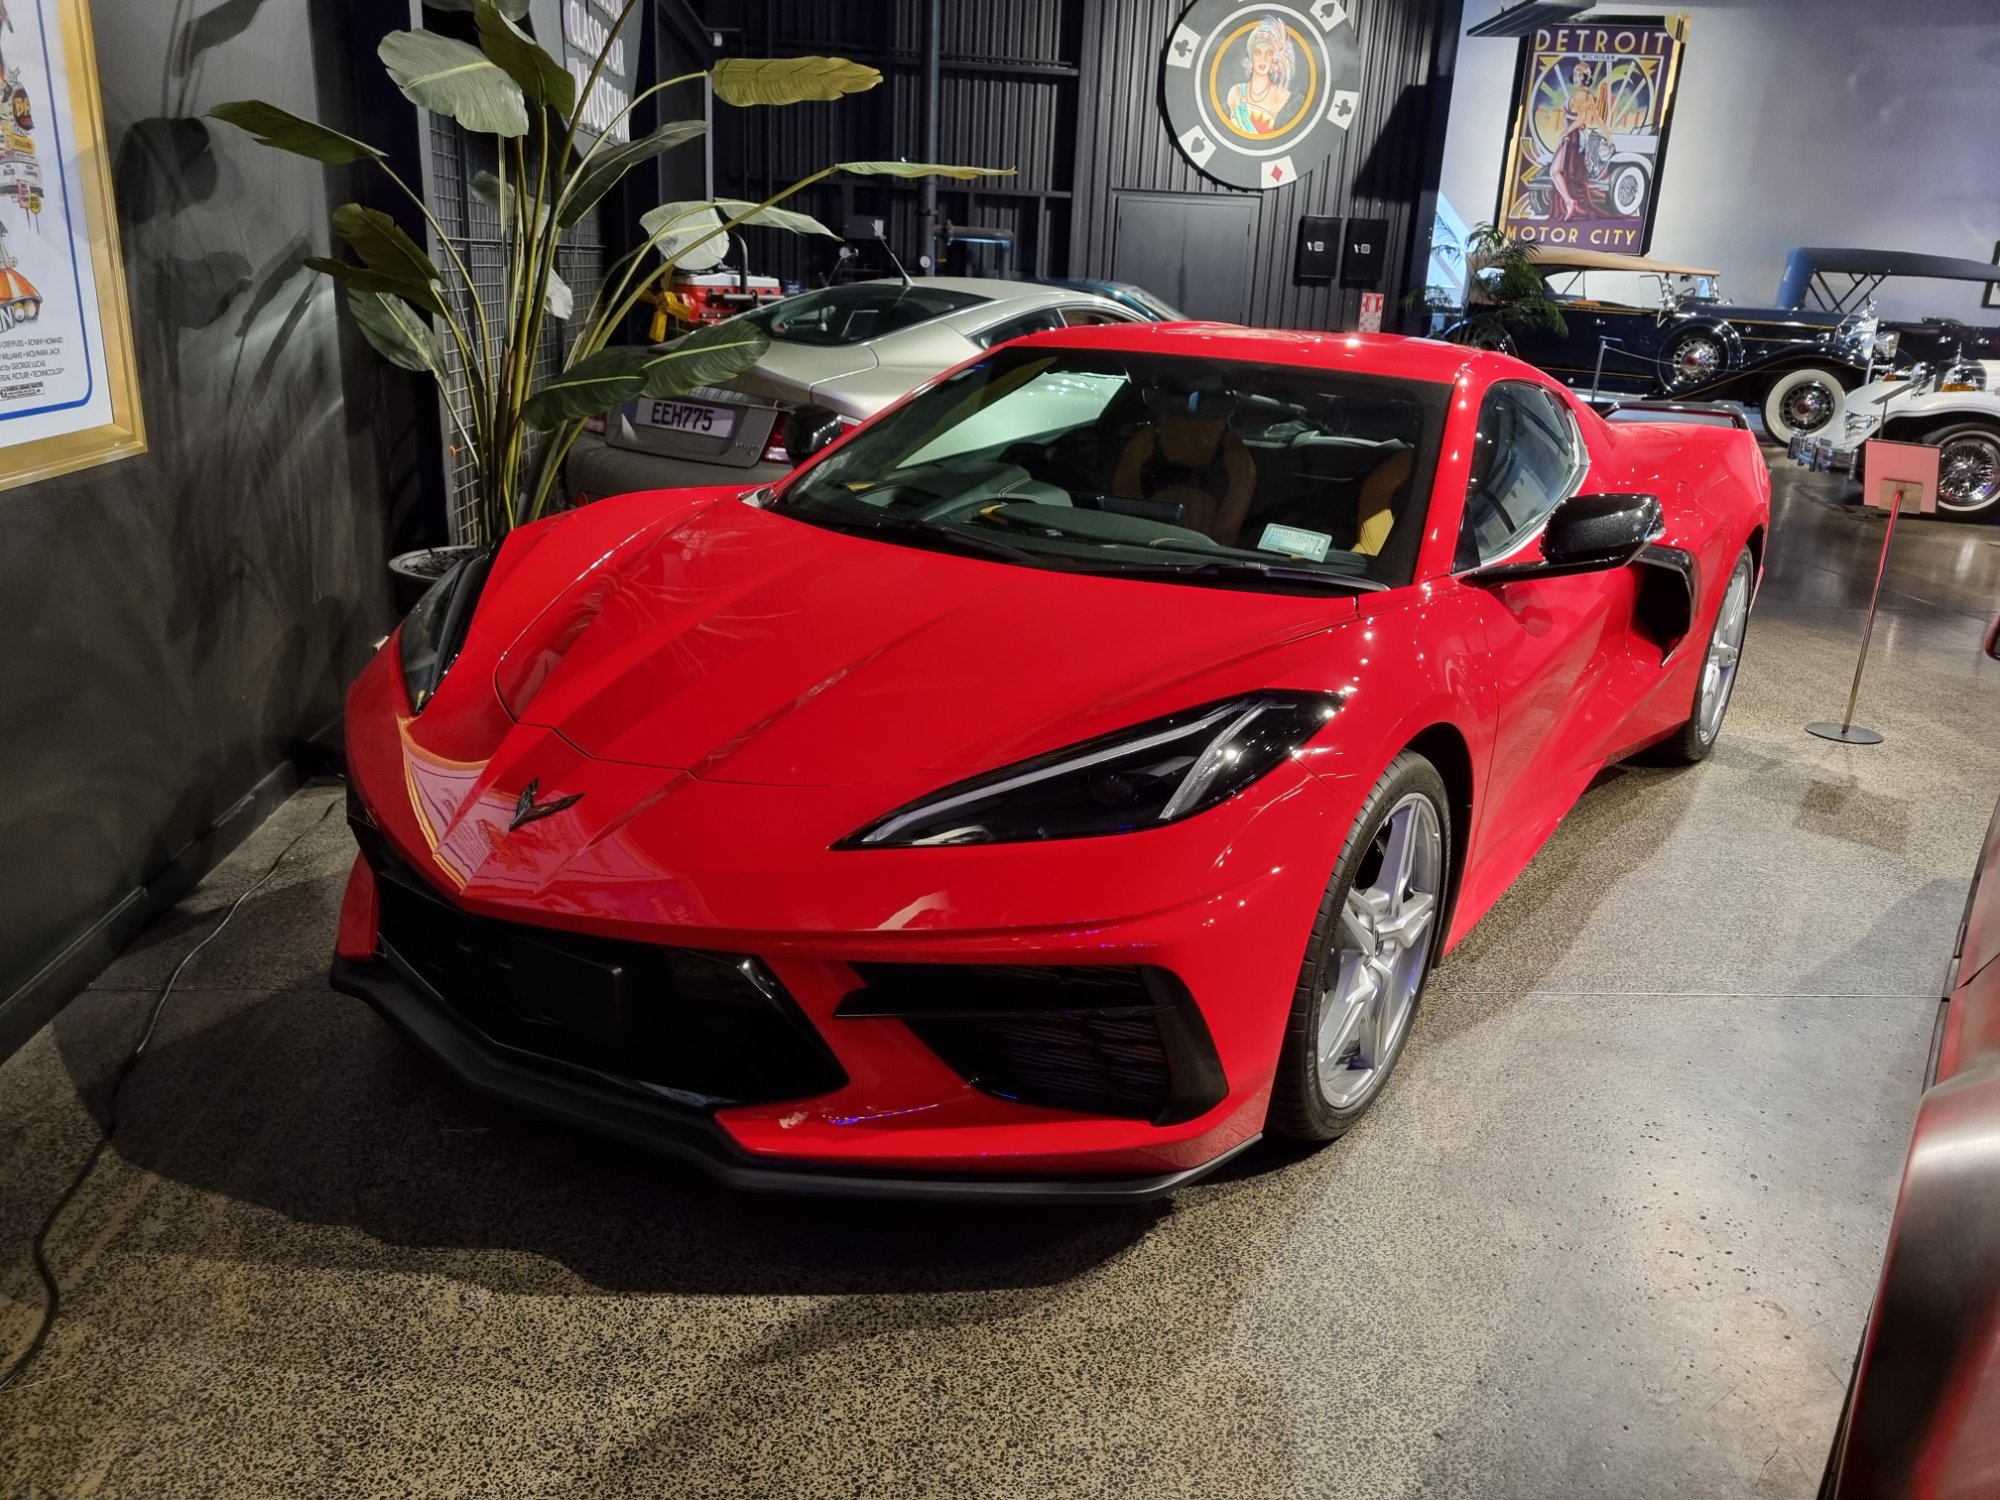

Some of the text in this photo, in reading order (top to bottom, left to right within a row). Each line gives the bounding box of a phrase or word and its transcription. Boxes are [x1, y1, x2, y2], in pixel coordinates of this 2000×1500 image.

[569, 0, 609, 66] CLASSIC
[1534, 29, 1669, 55] DETROIT
[568, 58, 630, 143] MUSEUM
[1505, 226, 1637, 246] MOTOR CITY
[651, 402, 714, 432] EEH775
